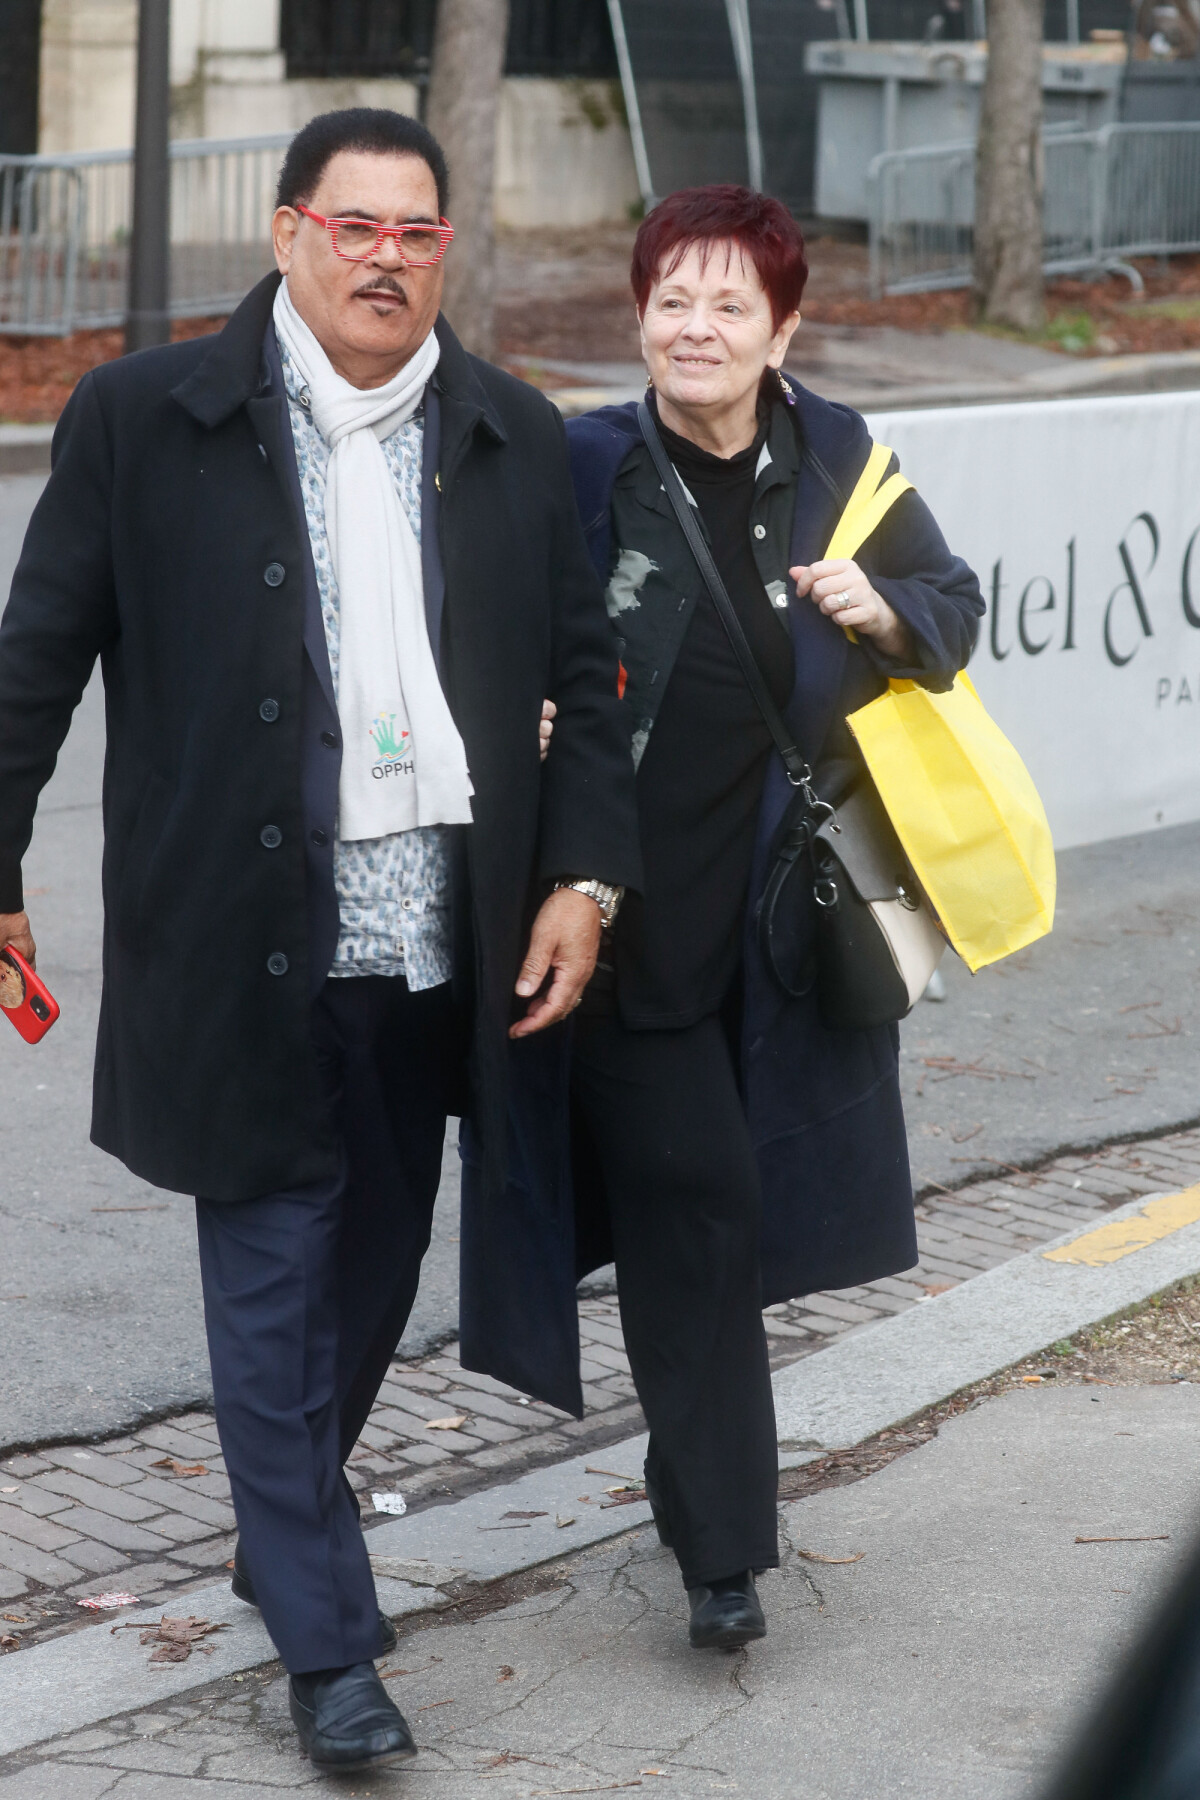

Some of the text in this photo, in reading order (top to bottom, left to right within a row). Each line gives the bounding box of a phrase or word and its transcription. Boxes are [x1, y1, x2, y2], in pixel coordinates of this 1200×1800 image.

[969, 534, 1077, 662] tel
[1104, 511, 1160, 667] &
[1155, 674, 1200, 709] PA
[371, 760, 415, 780] OPPH
